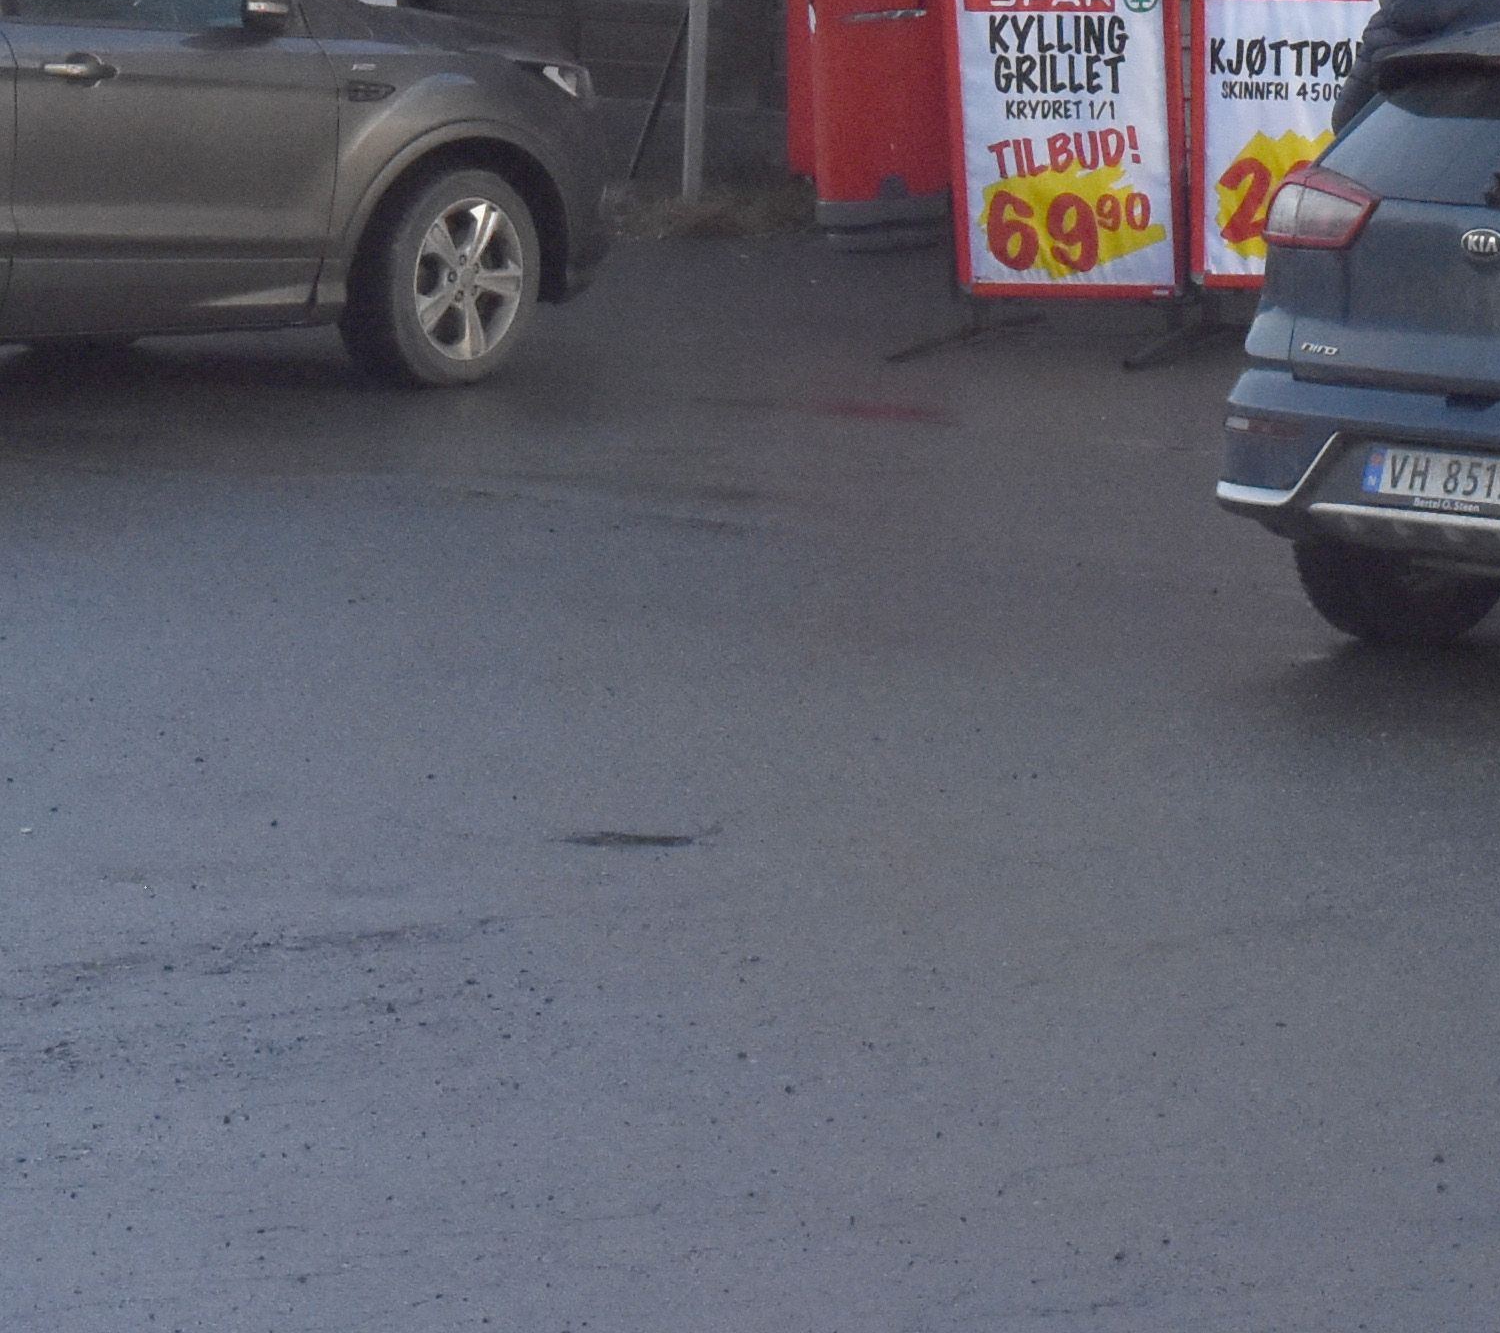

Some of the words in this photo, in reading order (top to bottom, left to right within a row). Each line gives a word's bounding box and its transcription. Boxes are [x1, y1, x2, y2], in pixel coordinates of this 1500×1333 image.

[988, 14, 1129, 56] KYLLING
[994, 54, 1126, 94] GRILLET
[1221, 80, 1289, 101] SKINNFRI
[1005, 100, 1082, 120] KRYDRET
[1088, 100, 1116, 121] 1/1
[988, 126, 1140, 179] TILBUD!
[1219, 157, 1312, 244] 2
[1467, 234, 1498, 253] KIA
[1390, 454, 1431, 492] VH
[1413, 496, 1440, 509] Bertel
[1454, 500, 1480, 513] Steen
